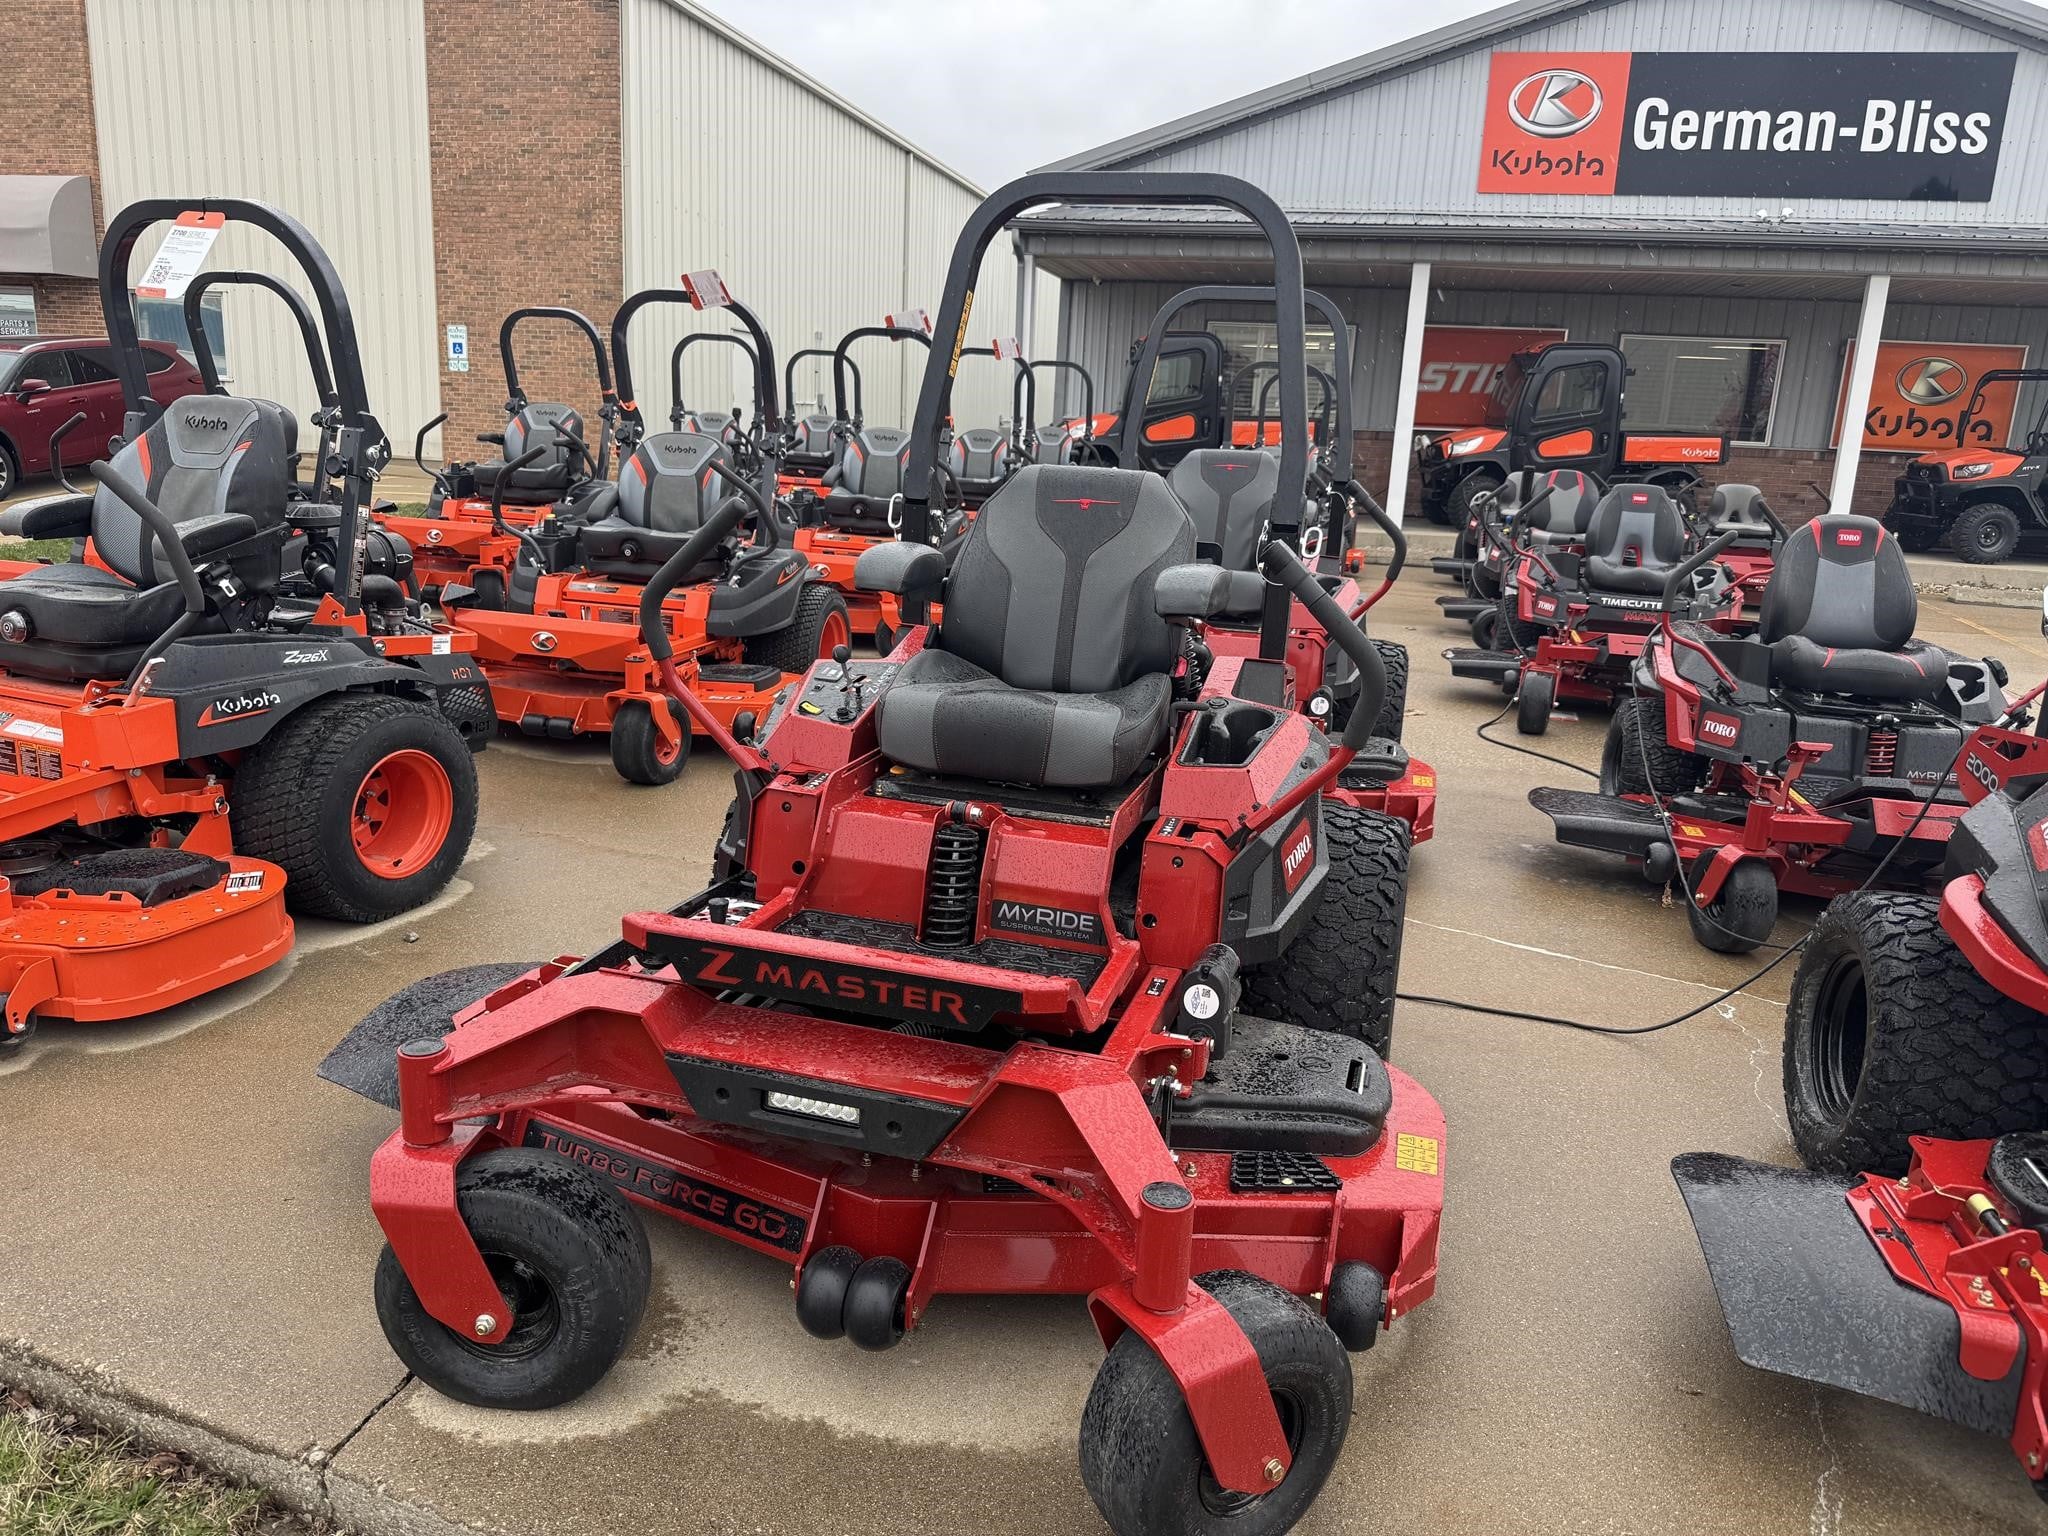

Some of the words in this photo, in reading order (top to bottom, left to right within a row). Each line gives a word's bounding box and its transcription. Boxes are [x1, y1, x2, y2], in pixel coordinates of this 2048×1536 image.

[1633, 97, 1991, 155] German-Bliss
[1492, 150, 1604, 176] Kubota
[185, 415, 228, 431] Kubota
[665, 445, 697, 454] Kubota
[1681, 447, 1719, 457] Kubota
[1839, 533, 1860, 541] TORO
[1537, 600, 1556, 612] TORO
[1601, 597, 1662, 609] TIMECUTTE
[282, 649, 328, 664] Z726X
[216, 692, 281, 713] Kubota
[1703, 720, 1736, 738] TORO
[1965, 751, 1999, 794] 2000
[1284, 834, 1313, 878] TORO
[1000, 920, 1053, 935] SUSPENSION
[1056, 929, 1090, 940] SYSTEM
[697, 948, 743, 985] Z
[755, 961, 969, 1026] MASTER
[540, 1131, 630, 1180] TURBO
[635, 1167, 728, 1216] FORCE
[733, 1203, 788, 1240] 60
